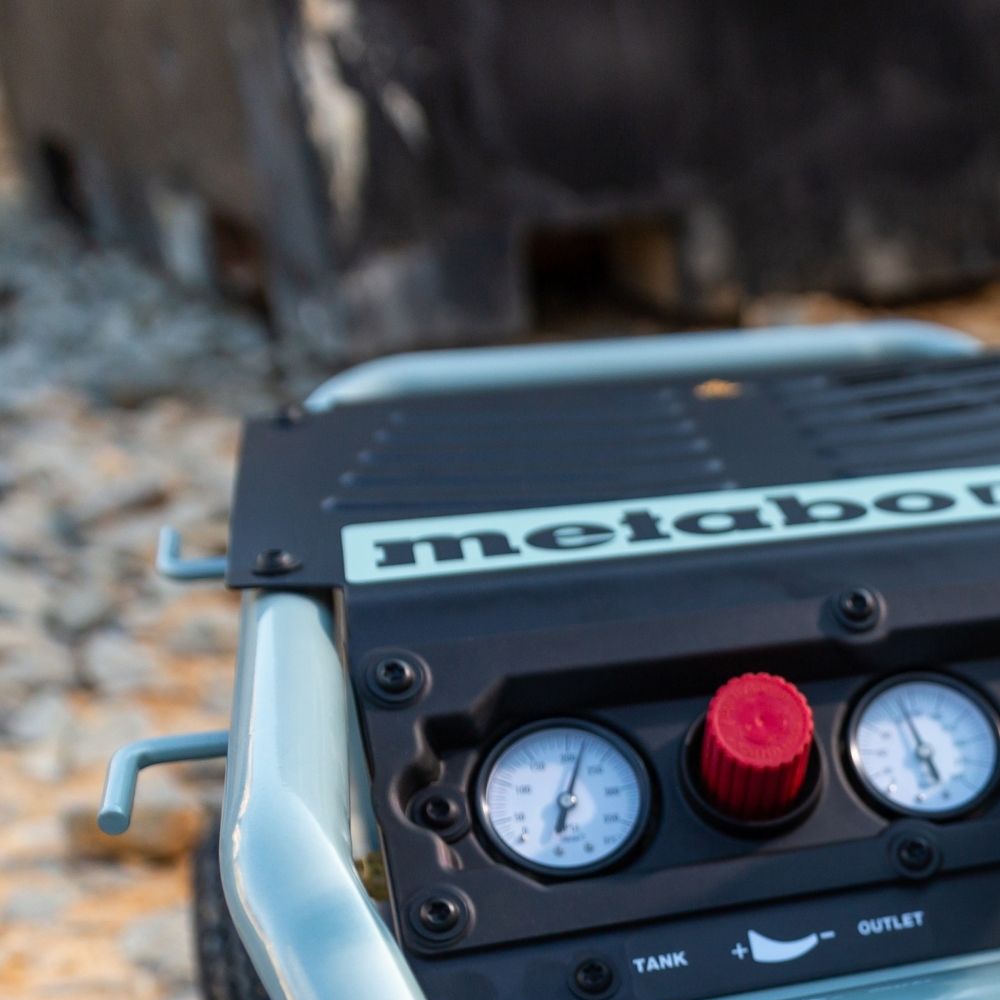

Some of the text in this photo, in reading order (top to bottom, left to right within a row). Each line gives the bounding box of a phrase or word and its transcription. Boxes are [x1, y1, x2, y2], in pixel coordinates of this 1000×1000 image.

[374, 495, 956, 568] metabo
[857, 910, 925, 936] OUTLET
[632, 950, 689, 974] TANK
